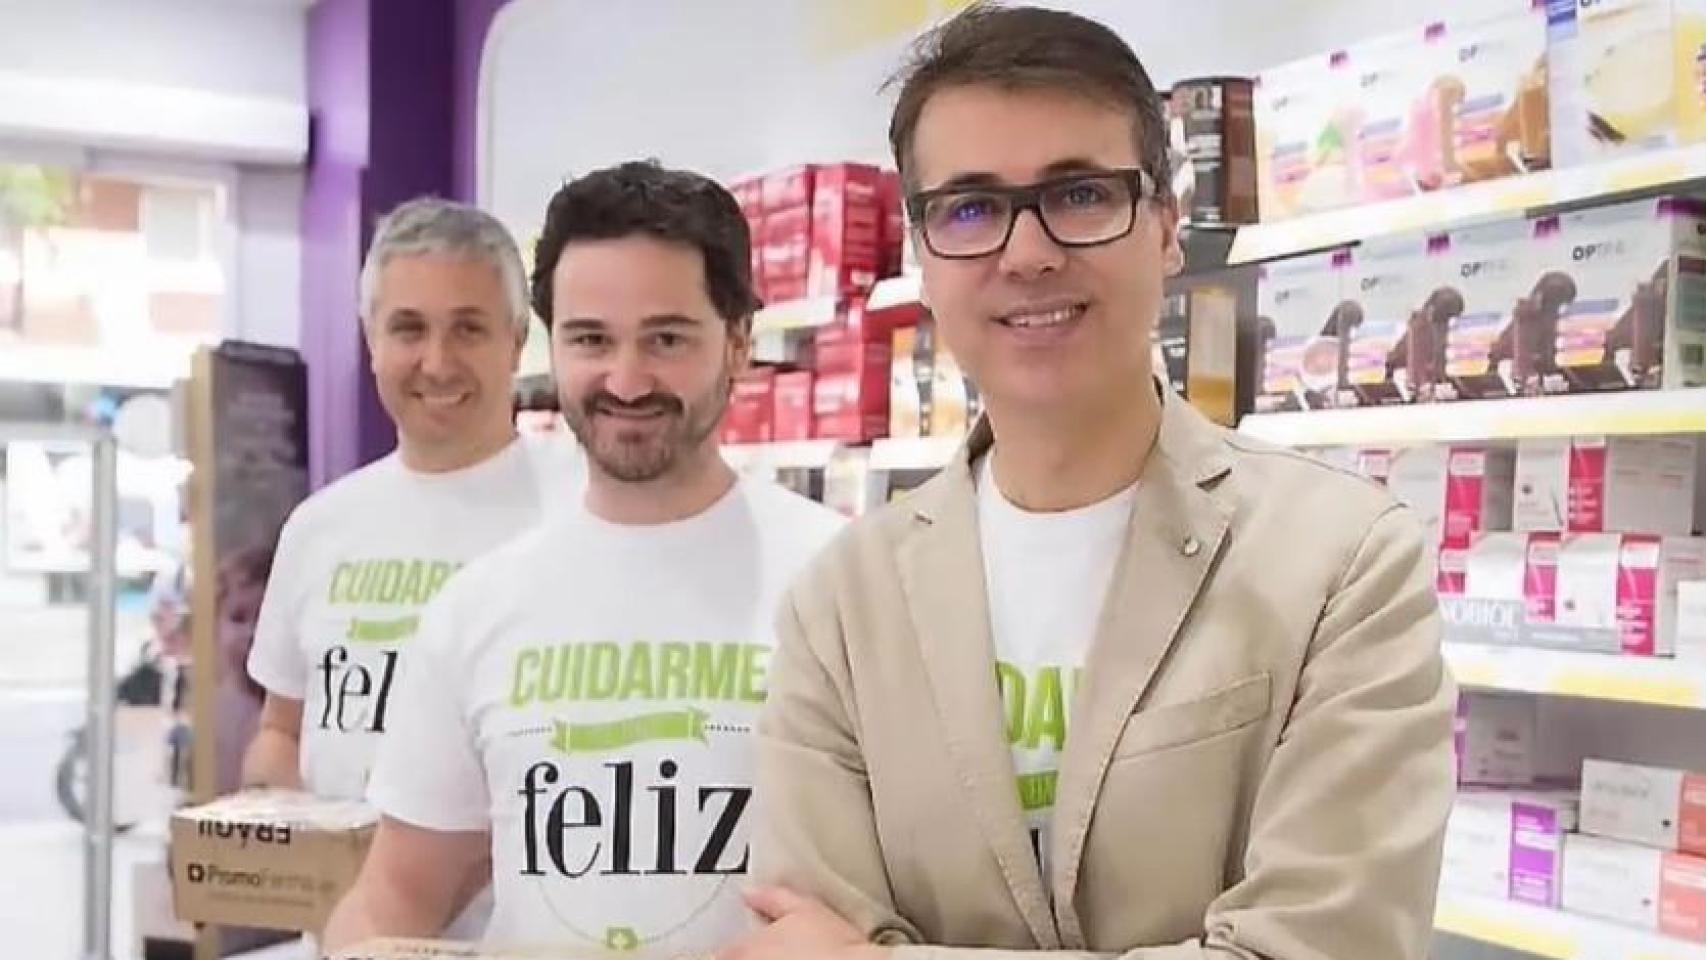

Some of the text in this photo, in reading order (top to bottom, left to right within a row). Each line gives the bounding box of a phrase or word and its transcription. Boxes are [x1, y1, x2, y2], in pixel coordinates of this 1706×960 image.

[316, 645, 398, 733] fel
[510, 641, 769, 705] CUIDARME
[517, 759, 753, 878] feliz
